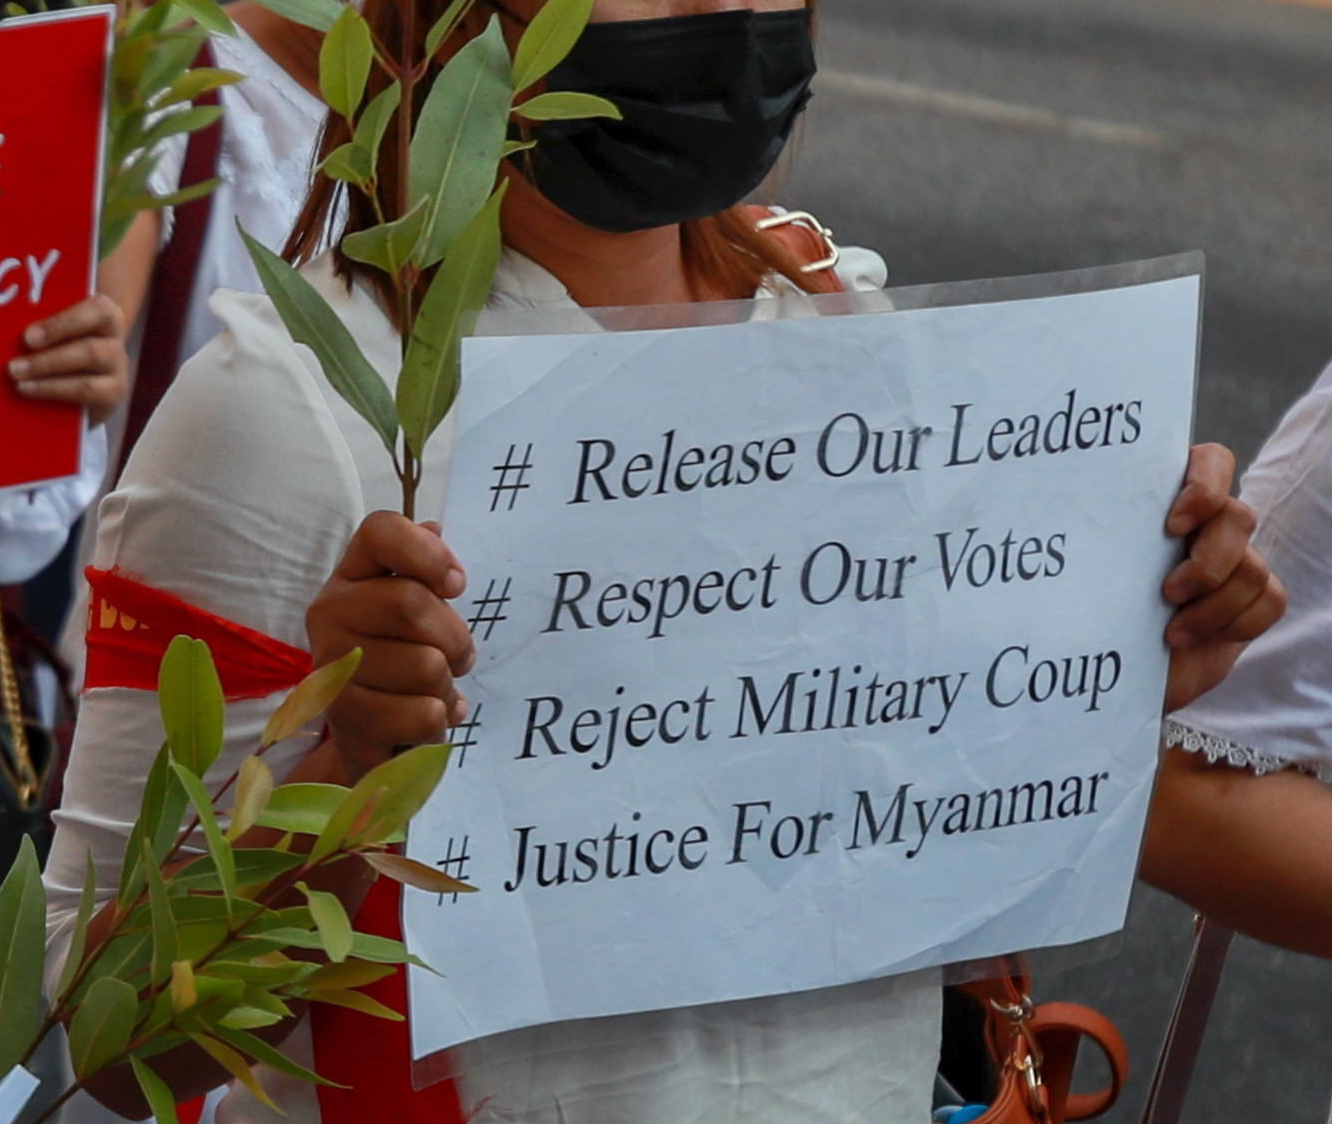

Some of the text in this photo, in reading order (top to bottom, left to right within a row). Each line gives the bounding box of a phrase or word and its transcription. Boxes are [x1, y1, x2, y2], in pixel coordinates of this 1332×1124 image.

[567, 429, 796, 504] Release
[817, 413, 933, 478] Our
[944, 389, 1143, 468] Leaders
[540, 554, 782, 639] Respect
[800, 542, 917, 606] Our
[934, 528, 1067, 592] Votes
[514, 686, 716, 770] Reject
[729, 663, 969, 738] Military
[986, 645, 1122, 713] Coup
[504, 811, 709, 892] Justice
[726, 801, 834, 864] For
[845, 772, 1110, 859] Myanmar
